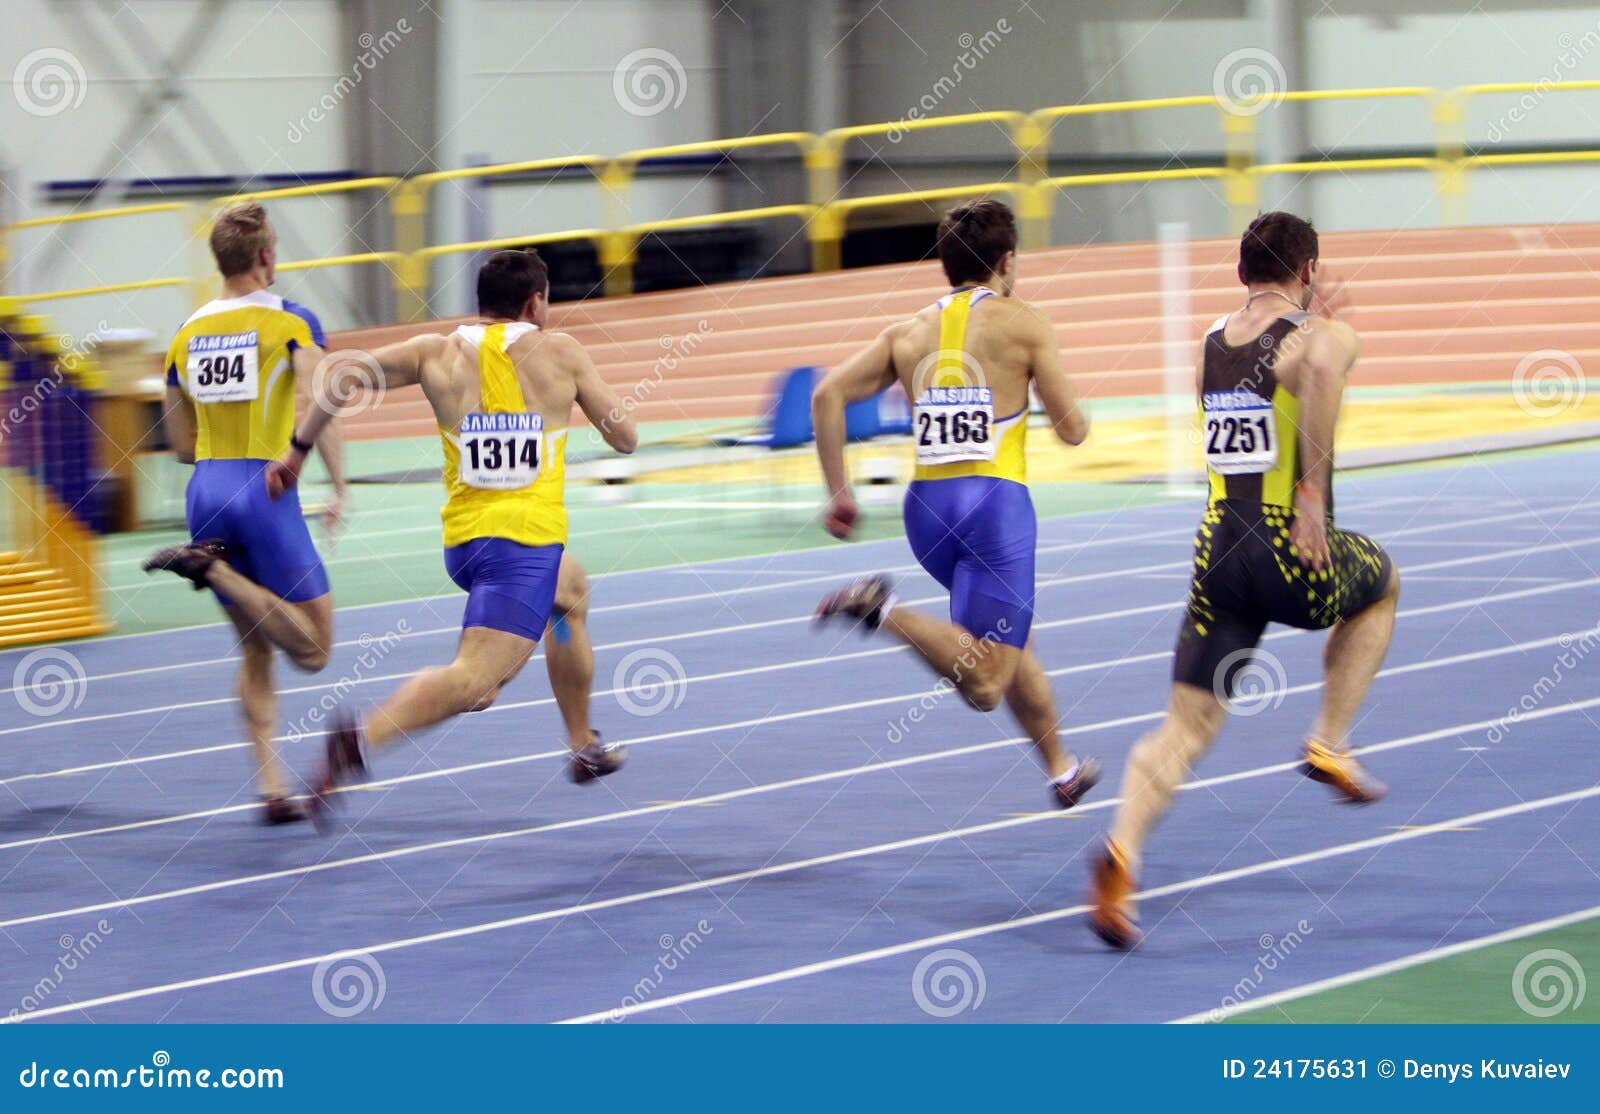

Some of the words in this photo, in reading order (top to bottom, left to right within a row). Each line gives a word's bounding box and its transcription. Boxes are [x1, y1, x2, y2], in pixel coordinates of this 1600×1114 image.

[197, 354, 246, 386] 394
[461, 414, 542, 431] SAMSUNG
[918, 411, 988, 446] 2163
[1207, 417, 1270, 454] 2251
[465, 438, 539, 470] 1314
